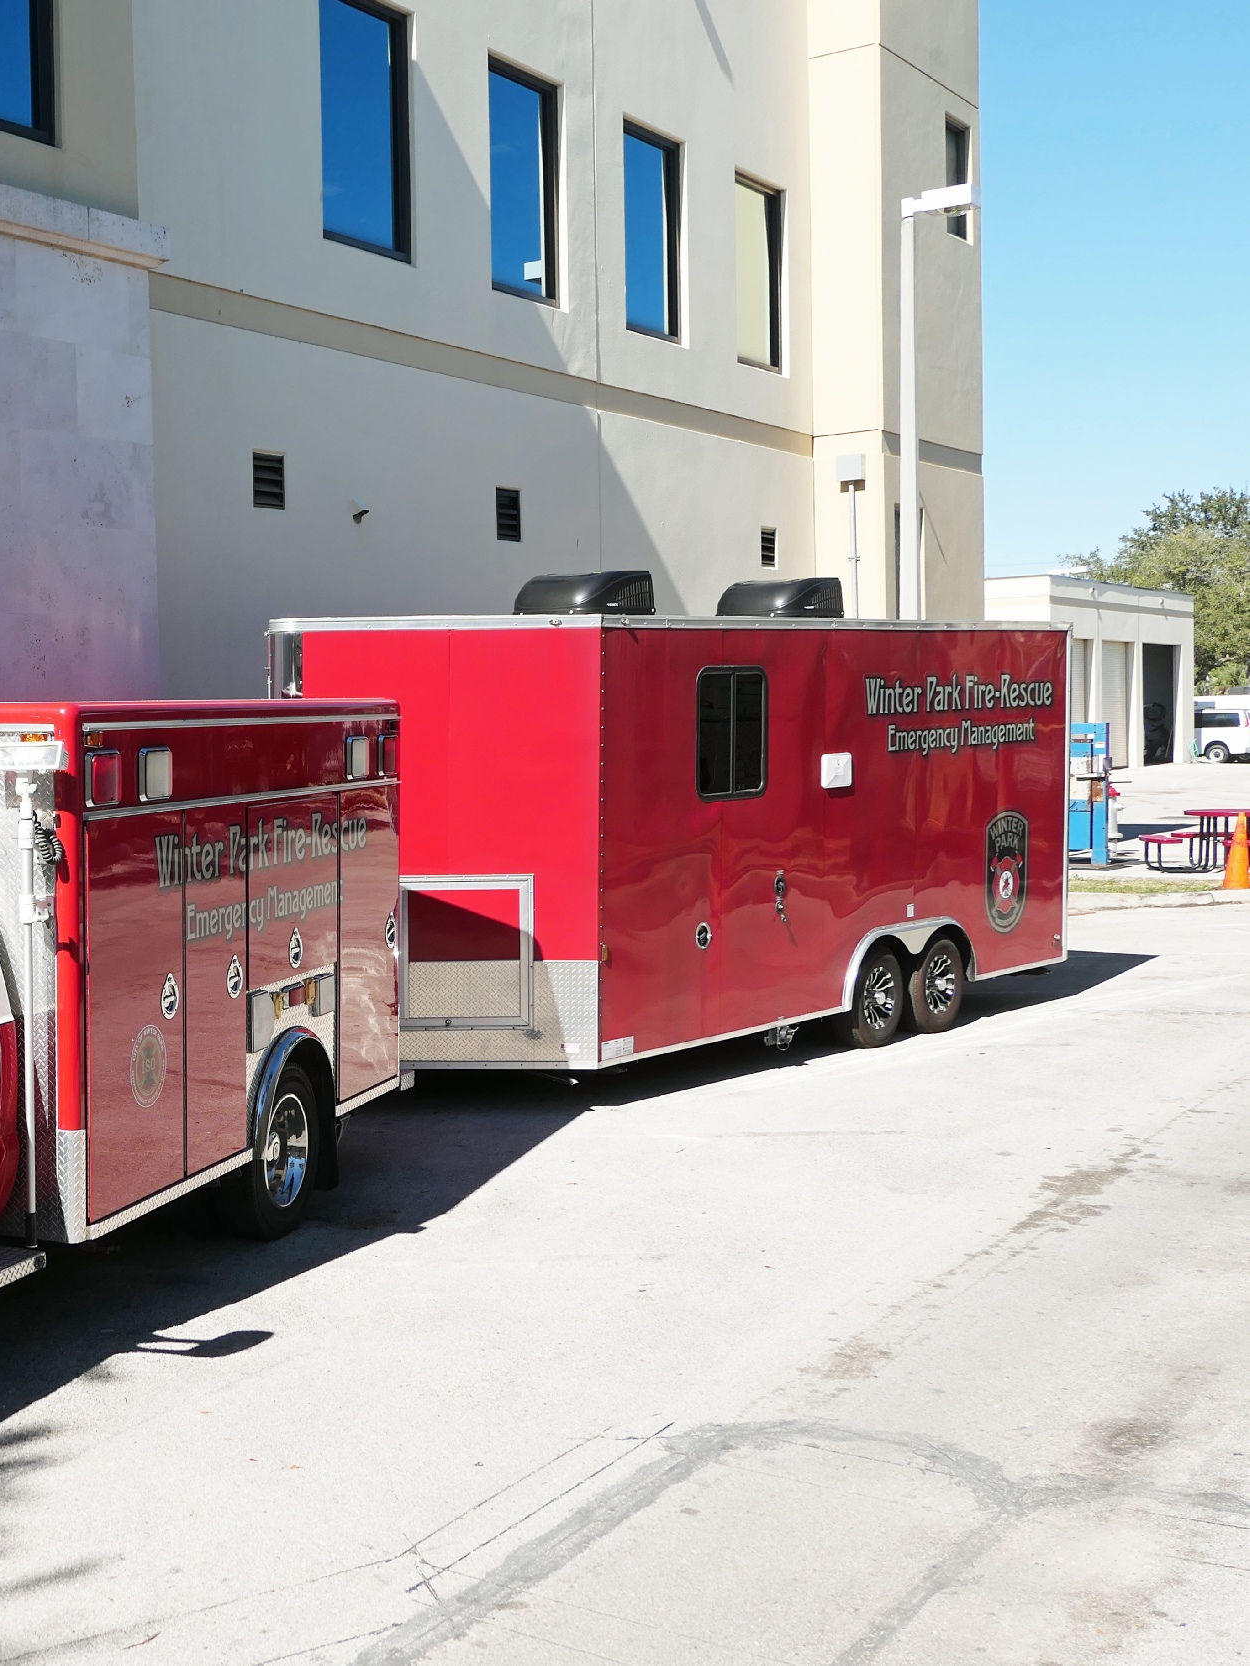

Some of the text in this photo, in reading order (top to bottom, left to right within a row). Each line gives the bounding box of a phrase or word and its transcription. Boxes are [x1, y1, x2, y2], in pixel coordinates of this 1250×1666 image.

[865, 674, 1053, 715] Winter Park Fire-Rescue
[887, 718, 1035, 755] Emergency Management
[990, 816, 1024, 840] WINTER
[995, 832, 1020, 852] PARK
[154, 812, 367, 888] Winter Park Fire-Rescue
[187, 897, 264, 941] Emergency
